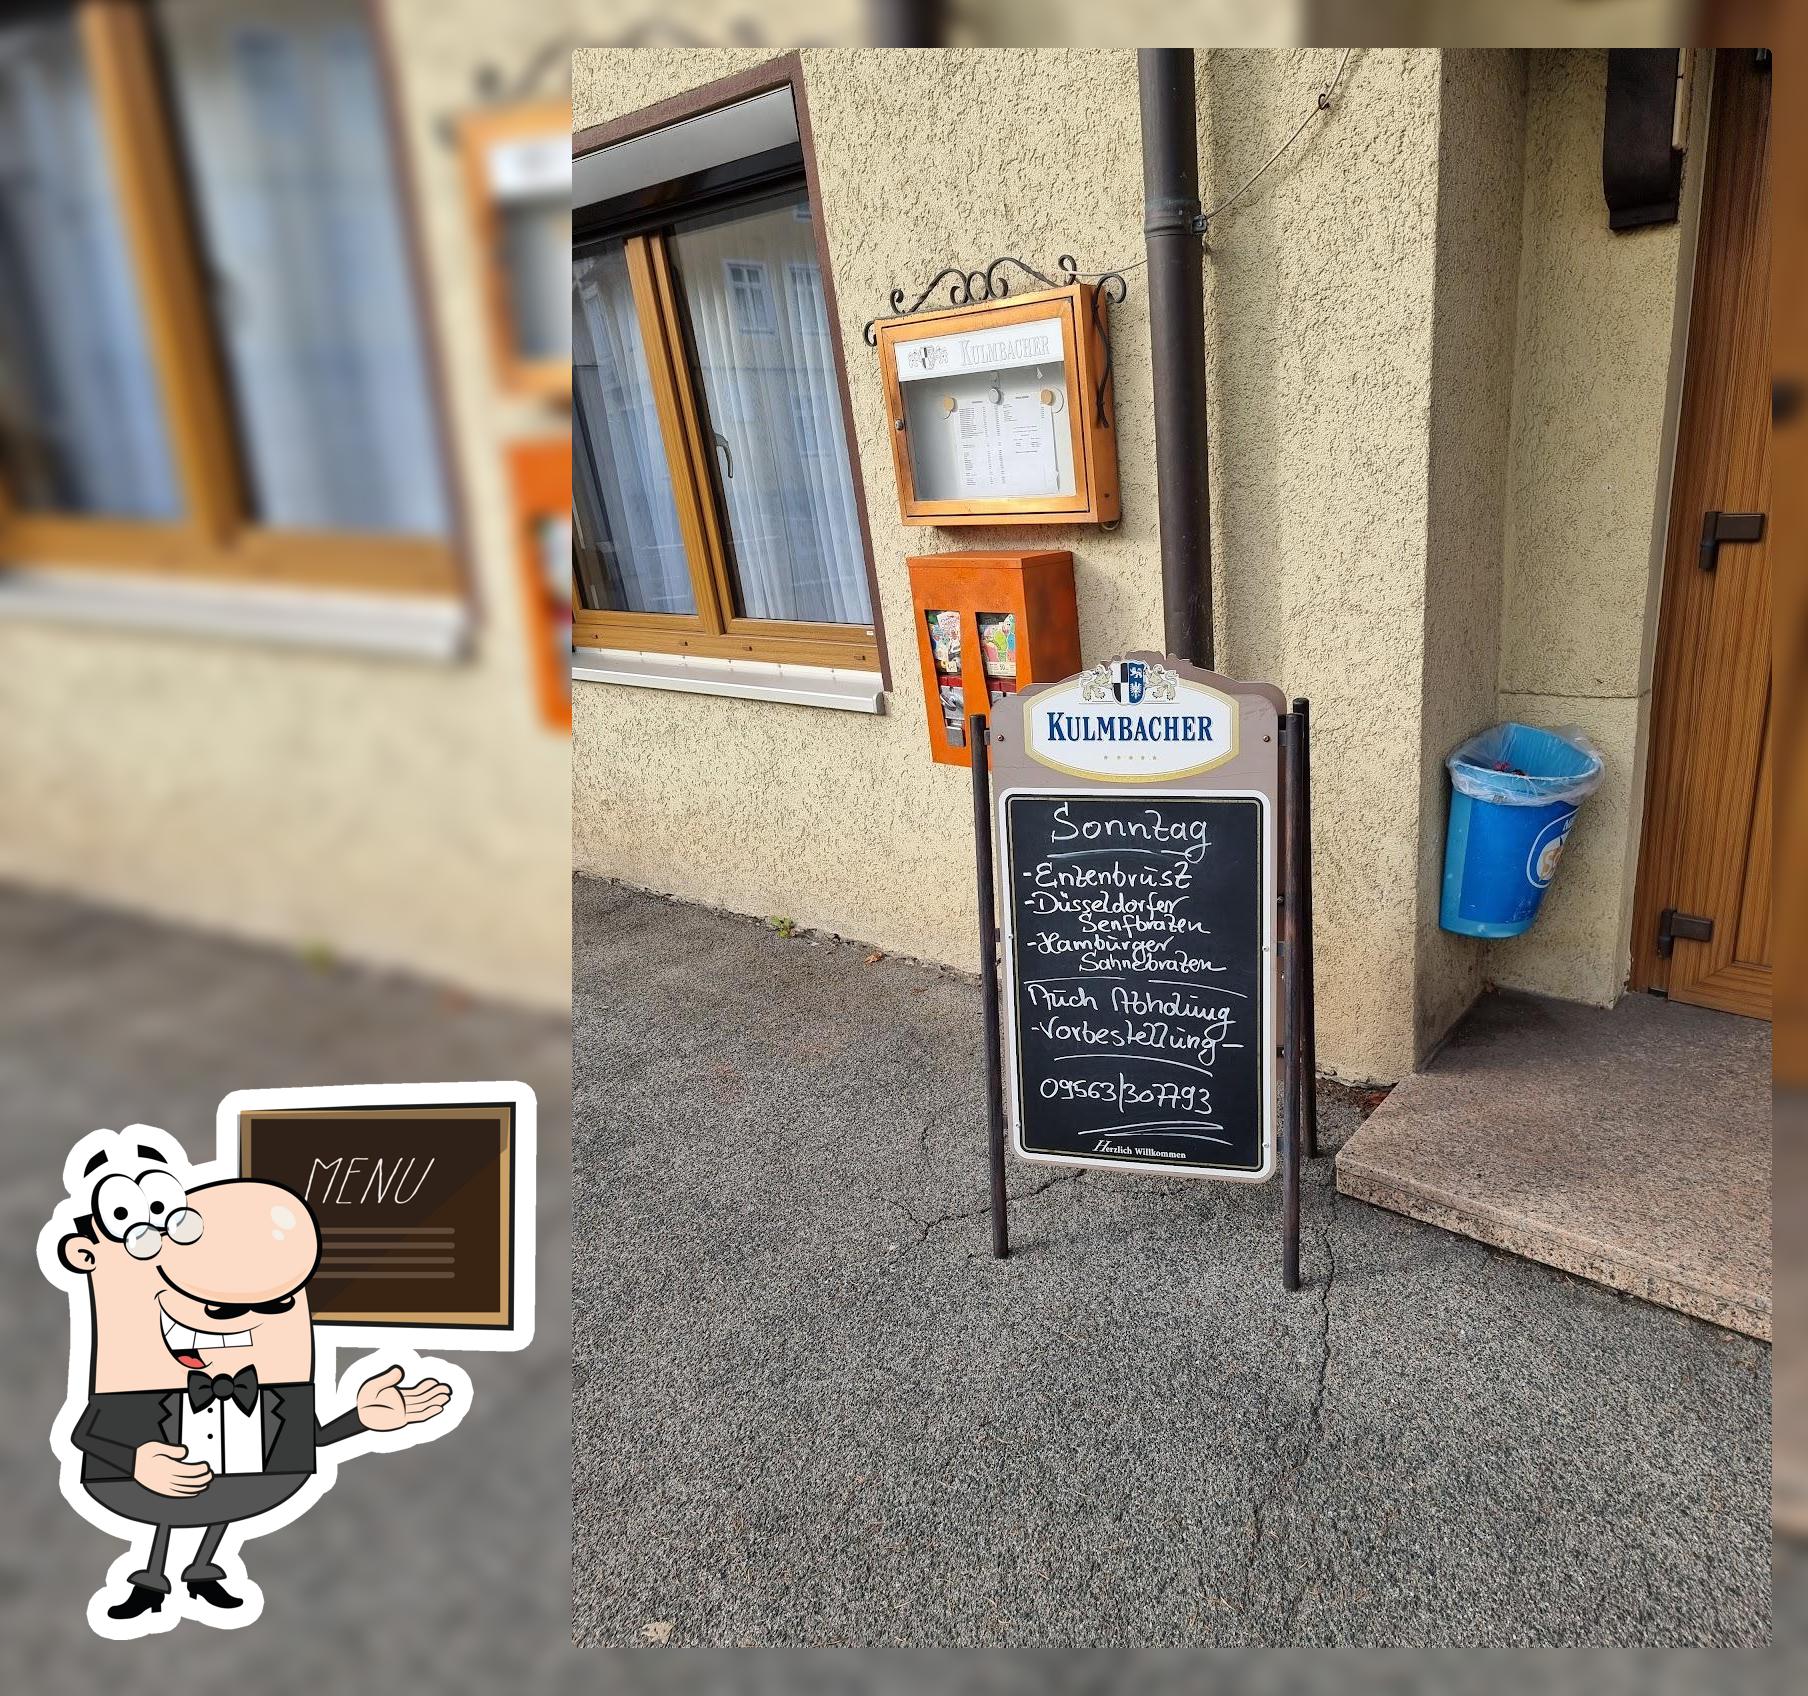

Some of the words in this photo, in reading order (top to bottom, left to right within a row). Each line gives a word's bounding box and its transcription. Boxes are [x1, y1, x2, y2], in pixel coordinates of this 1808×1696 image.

[960, 335, 1050, 367] KULMBACHER
[1046, 711, 1214, 742] KULMBACHER
[1051, 802, 1212, 863] Sonntag
[1078, 914, 1211, 938] Senfbraten
[1028, 984, 1099, 1011] Auch
[1111, 986, 1237, 1042] Abholung
[1092, 1139, 1133, 1156] Herzlich
[1134, 1147, 1187, 1160] Willkommen
